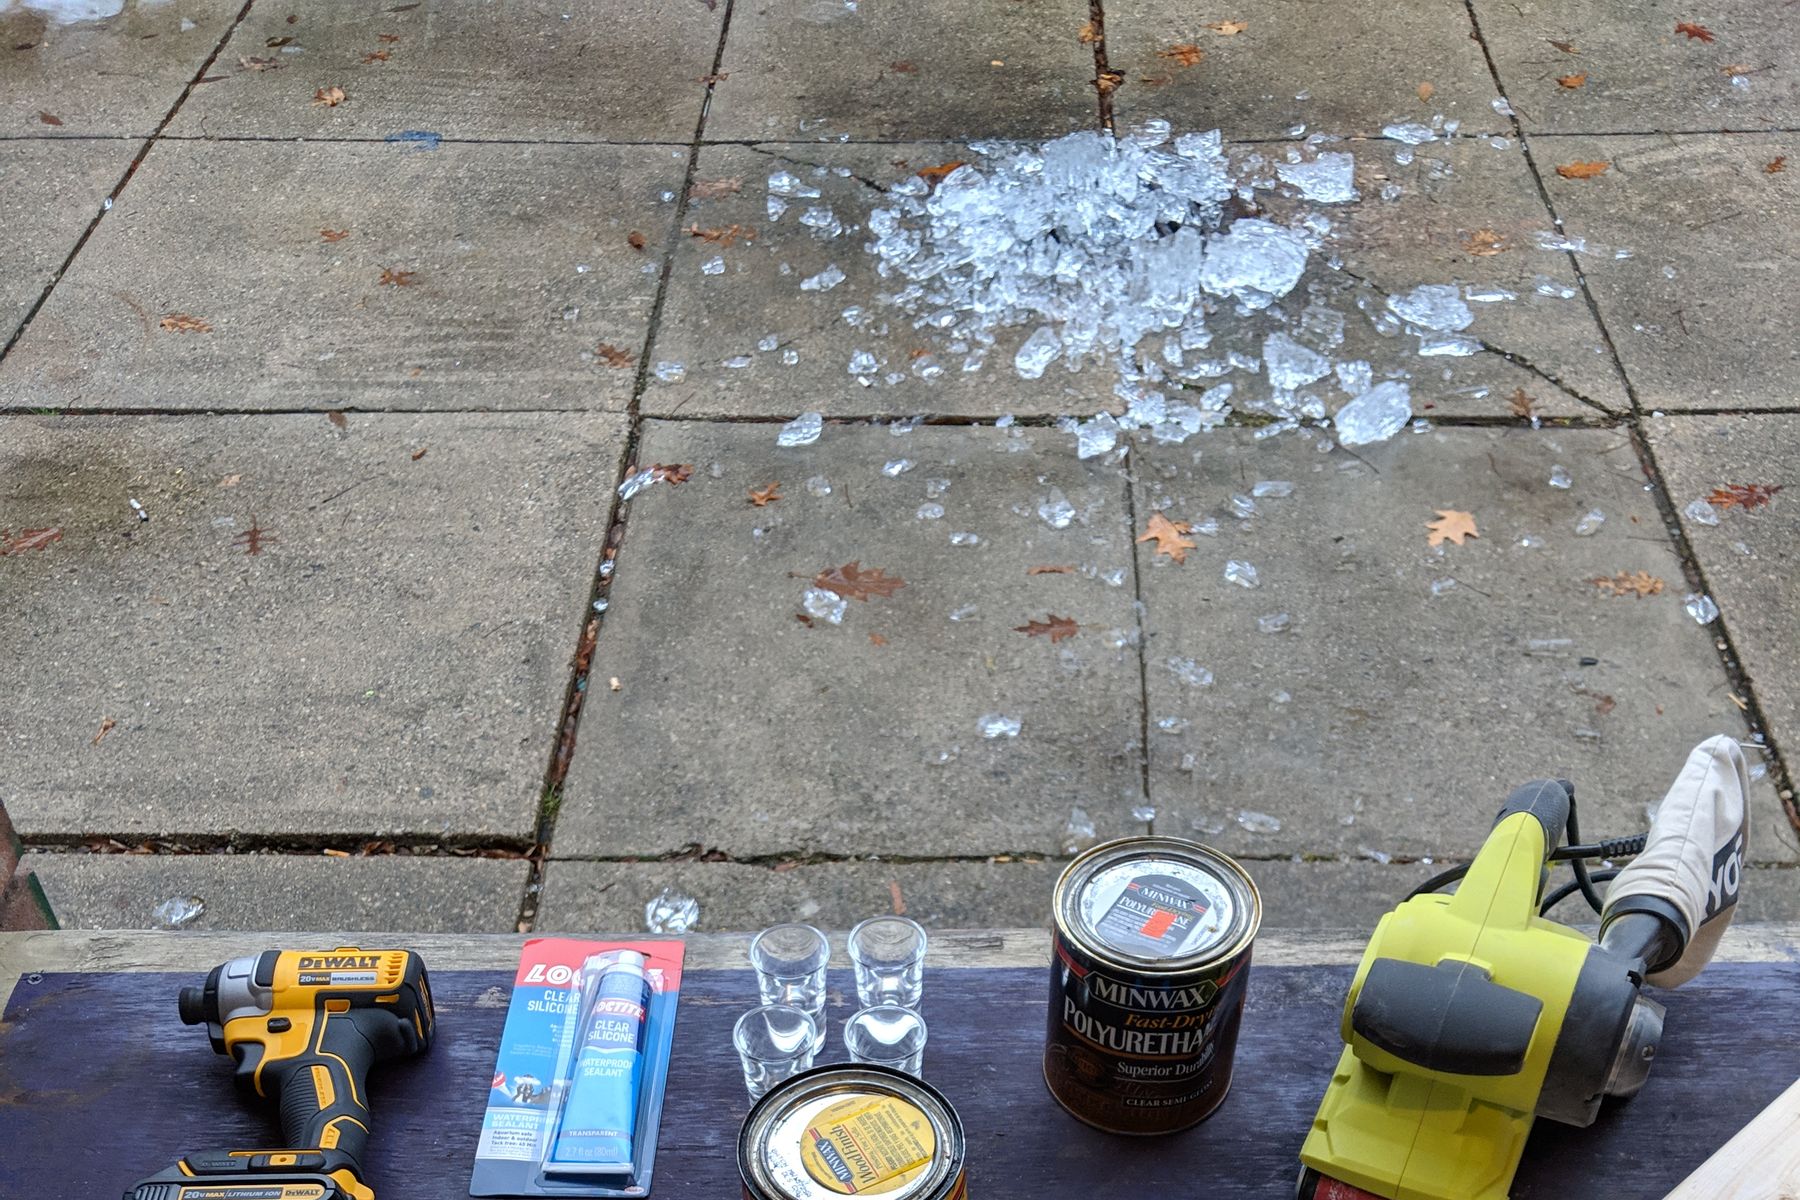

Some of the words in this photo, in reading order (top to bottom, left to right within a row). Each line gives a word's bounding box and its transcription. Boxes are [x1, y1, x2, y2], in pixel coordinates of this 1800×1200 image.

[1140, 888, 1189, 909] MINWAX
[543, 989, 581, 1001] CLEAR
[1094, 977, 1208, 1010] MINWAX
[527, 1000, 579, 1015] SILICONE
[594, 1020, 630, 1032] CLEAR
[588, 1031, 635, 1044] SILICONE
[583, 1067, 624, 1077] SEALANT
[1116, 1061, 1172, 1080] Superior
[1126, 1098, 1161, 1107] CLEAR
[817, 1140, 850, 1182] MINWAX
